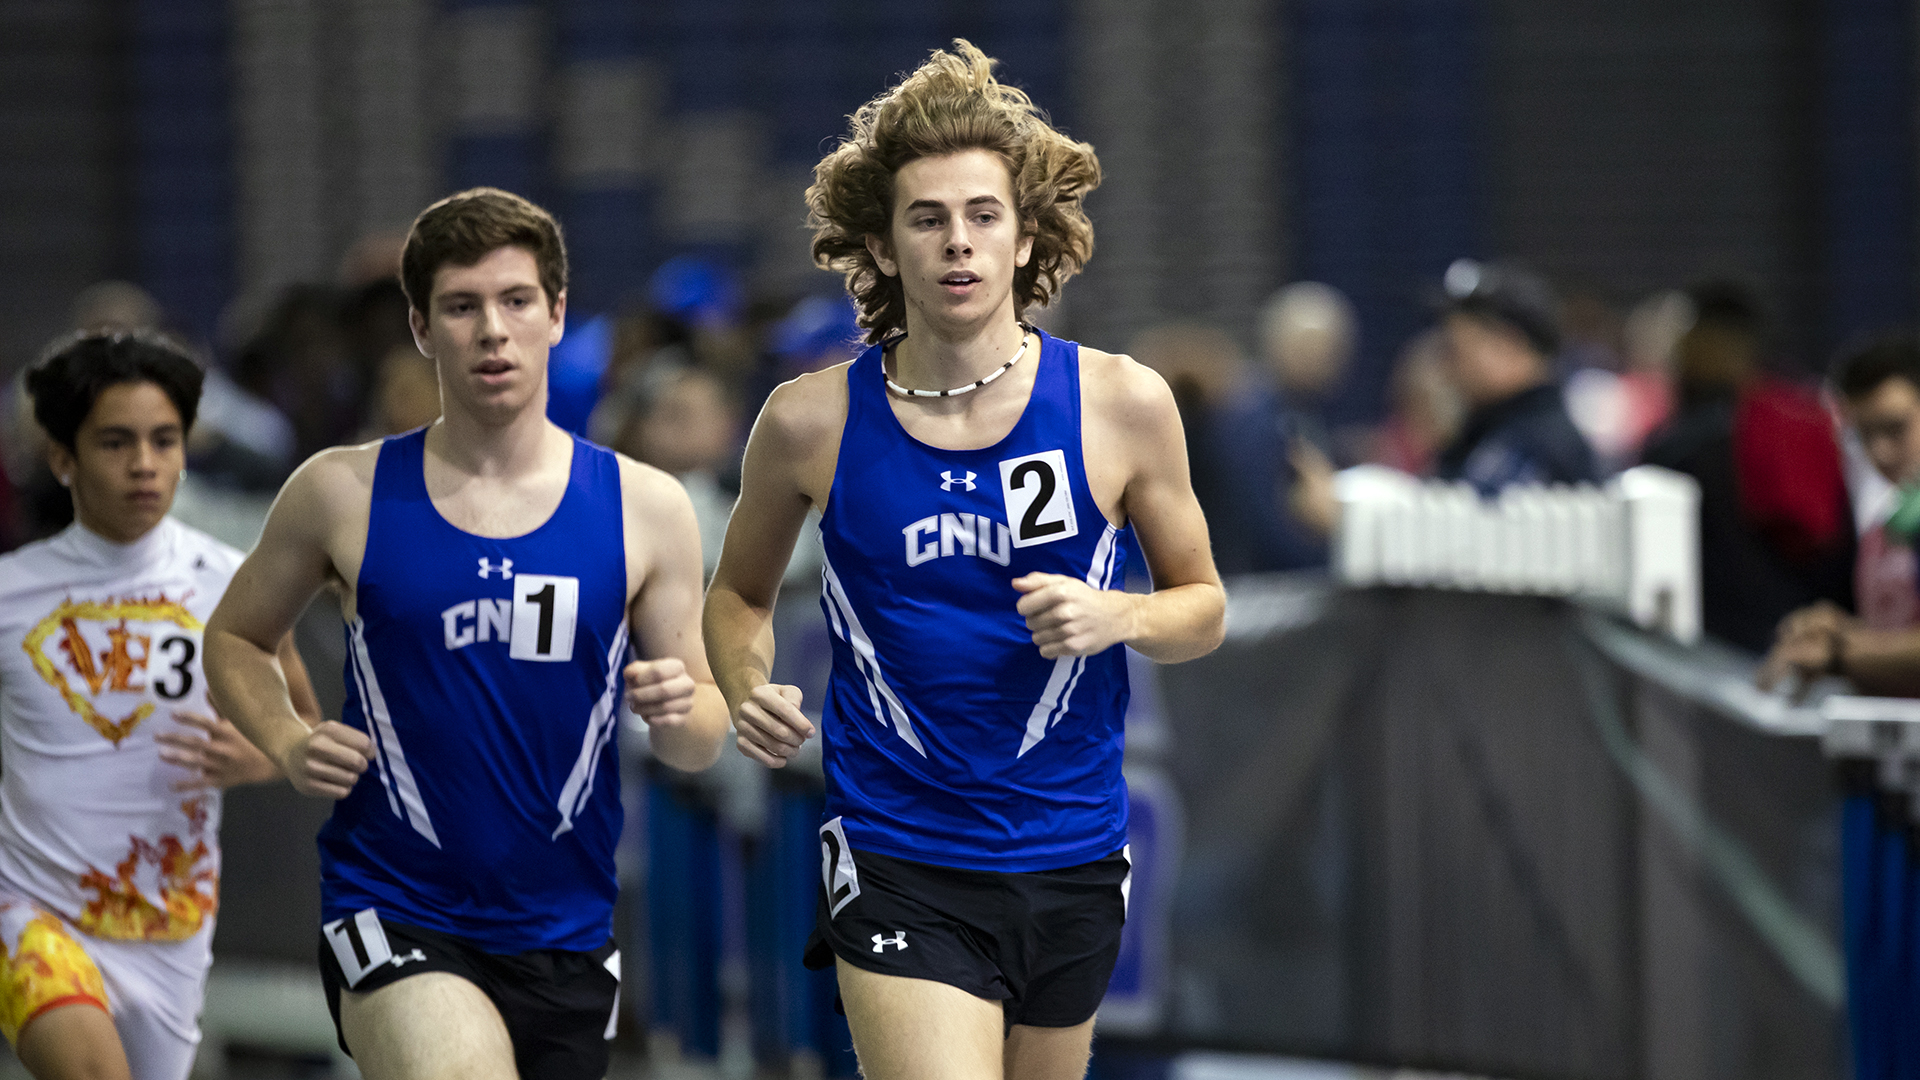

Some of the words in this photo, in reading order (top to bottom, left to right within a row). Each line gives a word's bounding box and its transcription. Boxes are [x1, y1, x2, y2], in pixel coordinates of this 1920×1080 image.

[1010, 460, 1066, 541] 2
[902, 512, 1011, 568] CNU
[441, 598, 513, 651] CN
[526, 584, 555, 655] 1
[154, 635, 195, 700] 3
[821, 829, 851, 912] 2
[334, 918, 371, 971] 1
